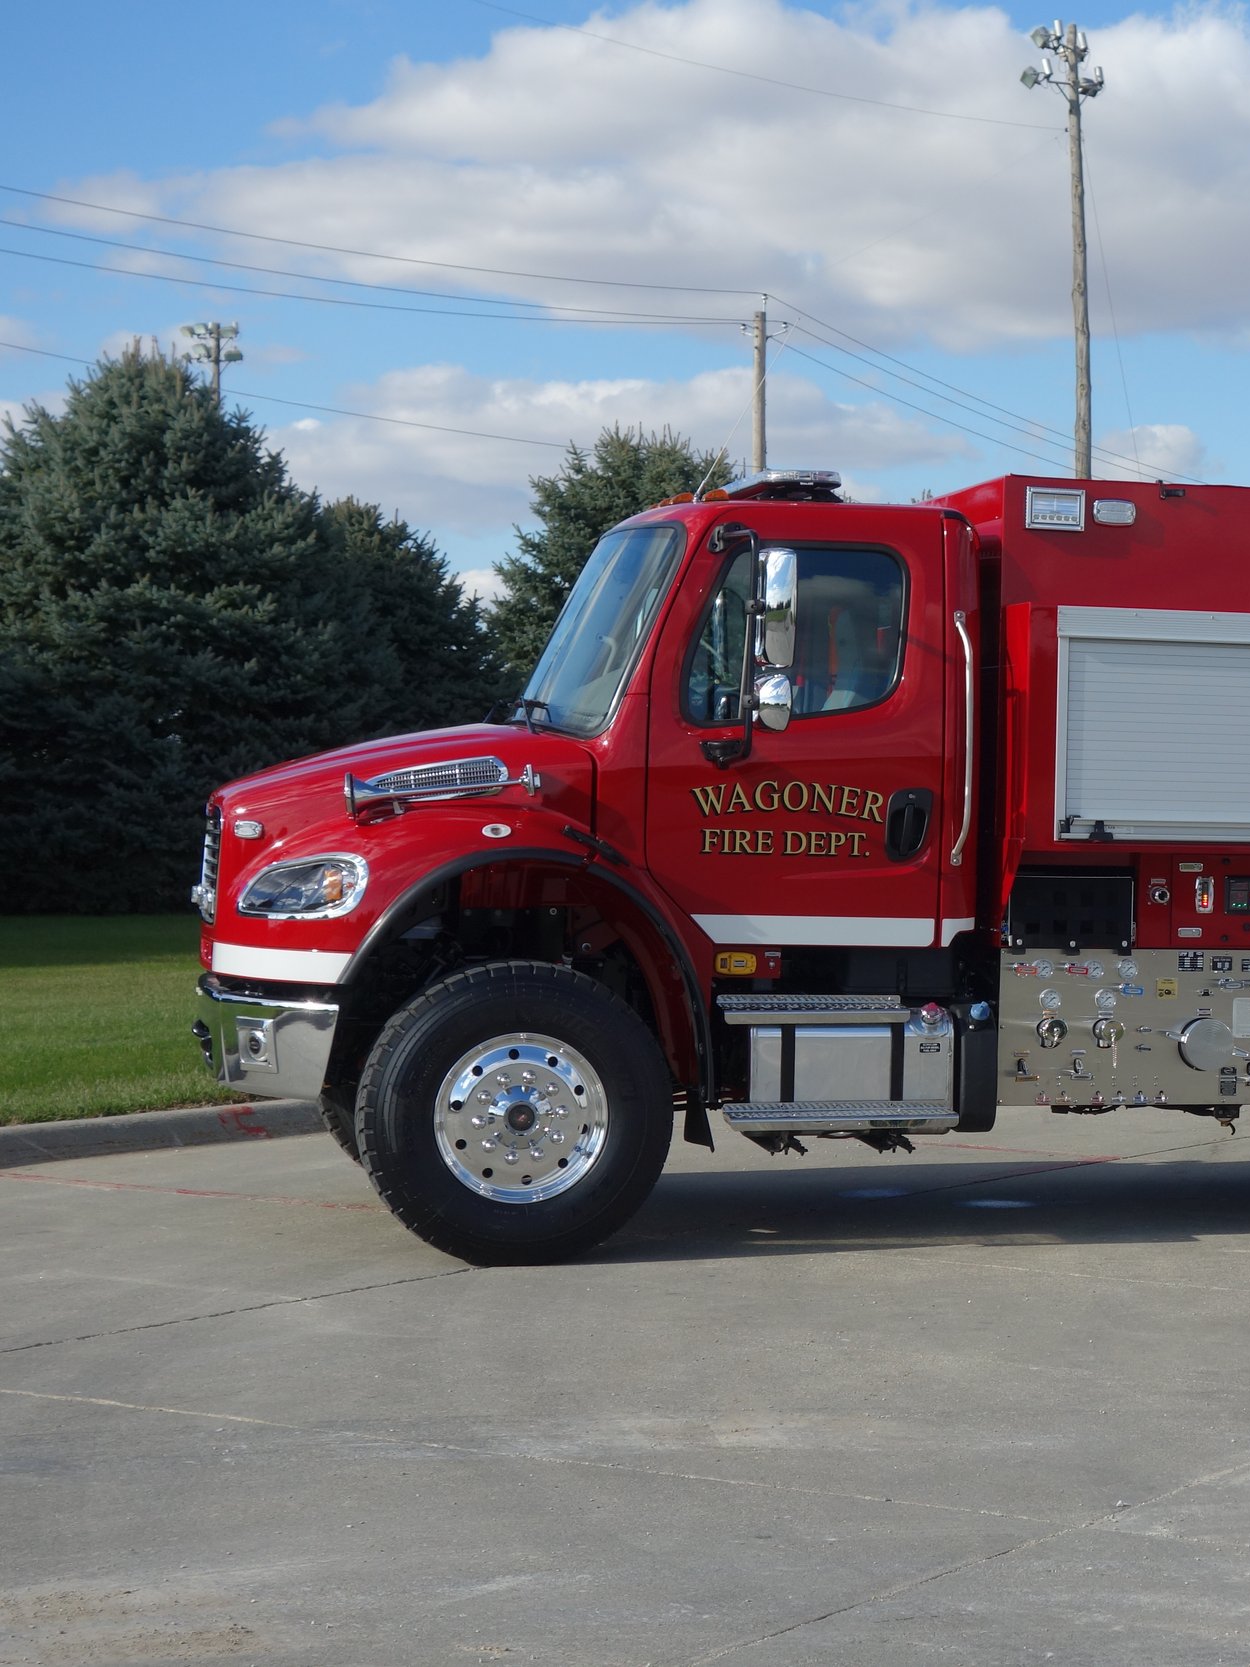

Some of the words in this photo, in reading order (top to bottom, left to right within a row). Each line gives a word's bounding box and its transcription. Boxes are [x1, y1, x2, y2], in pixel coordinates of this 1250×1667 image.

[691, 781, 884, 823] WAGONER
[702, 829, 774, 854] FIRE
[783, 830, 870, 857] DEPT.
